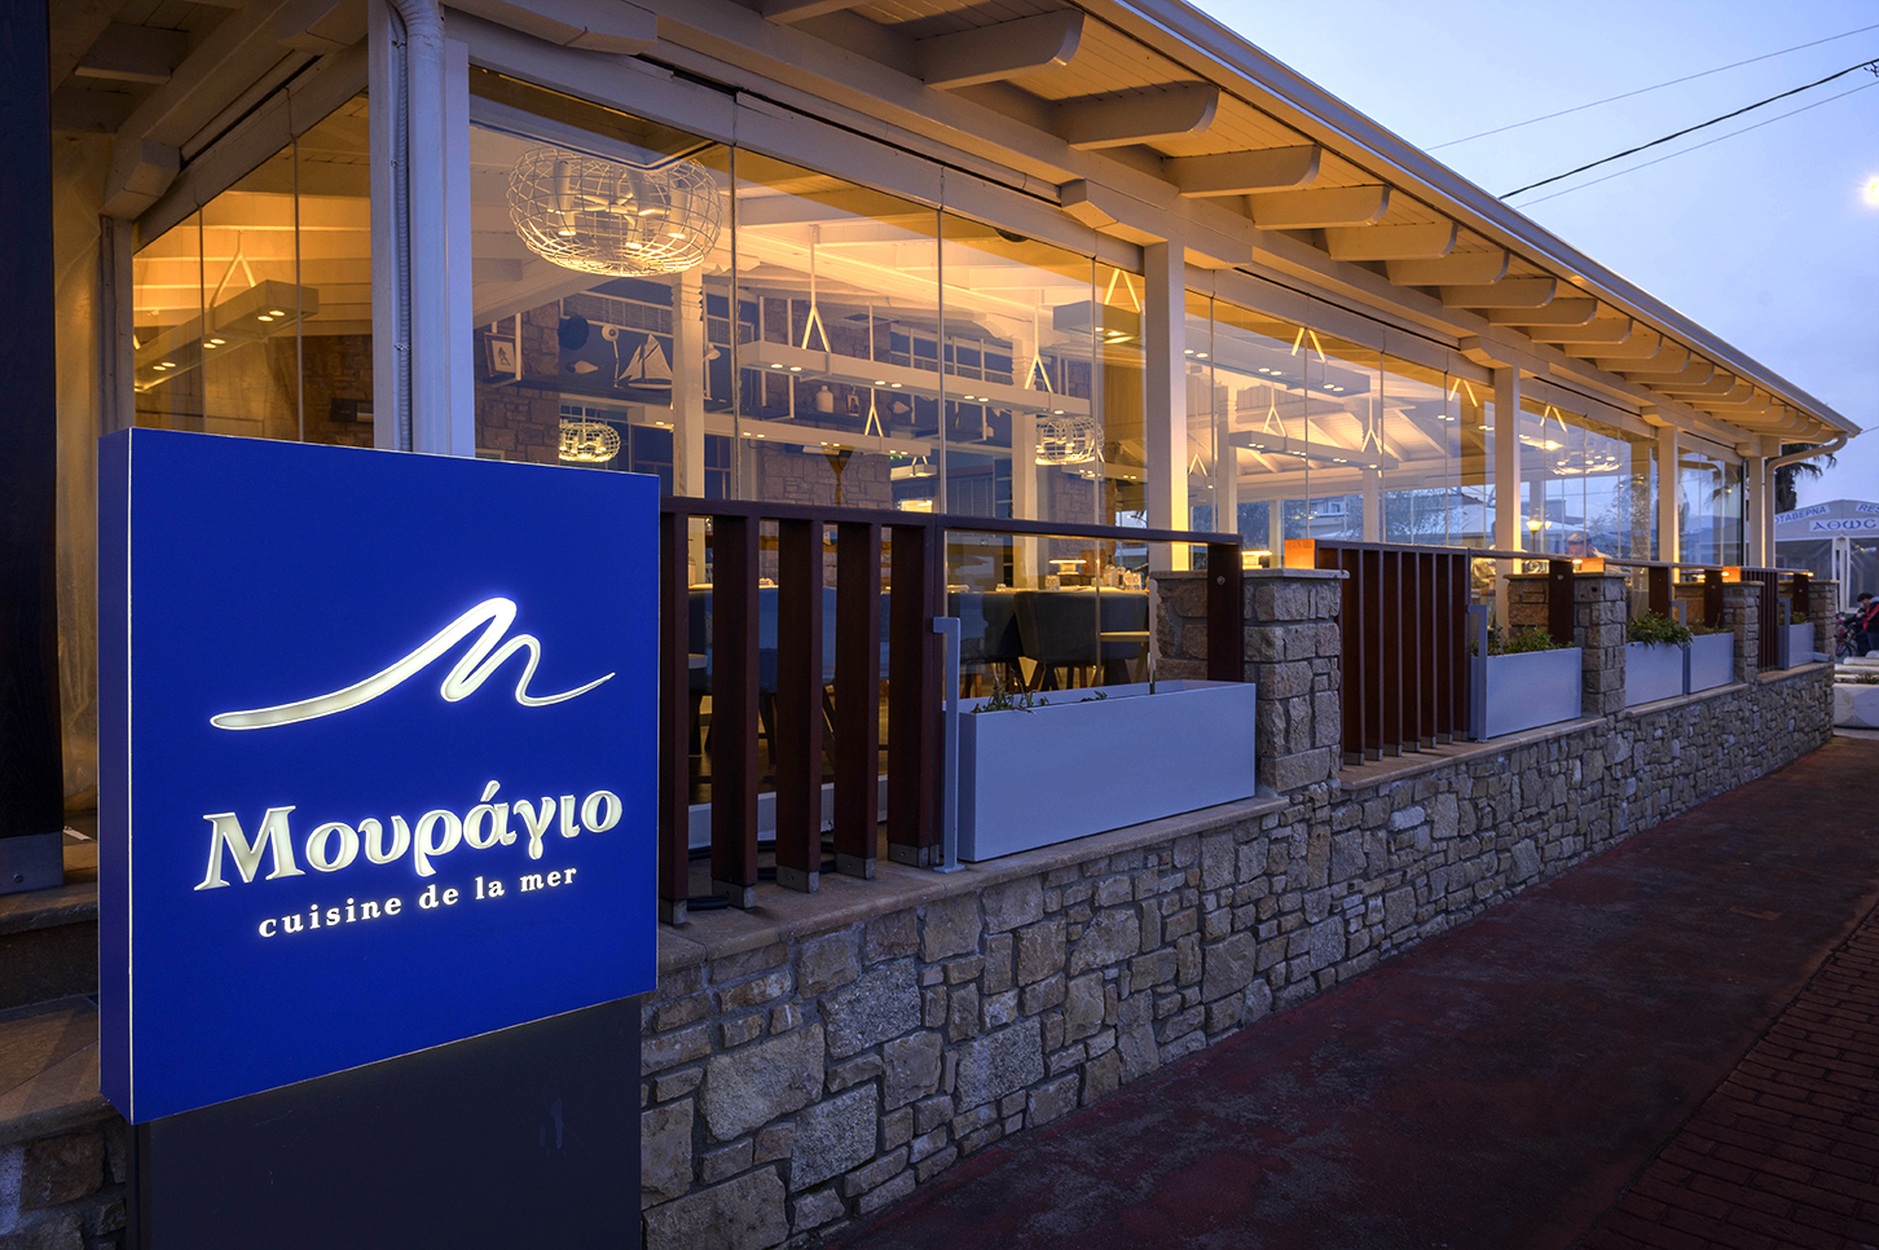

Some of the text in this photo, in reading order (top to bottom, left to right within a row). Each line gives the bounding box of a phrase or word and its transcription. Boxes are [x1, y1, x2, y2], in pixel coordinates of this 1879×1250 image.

[193, 779, 623, 891] Μουράγιο
[257, 867, 578, 939] cuisine de la mer
